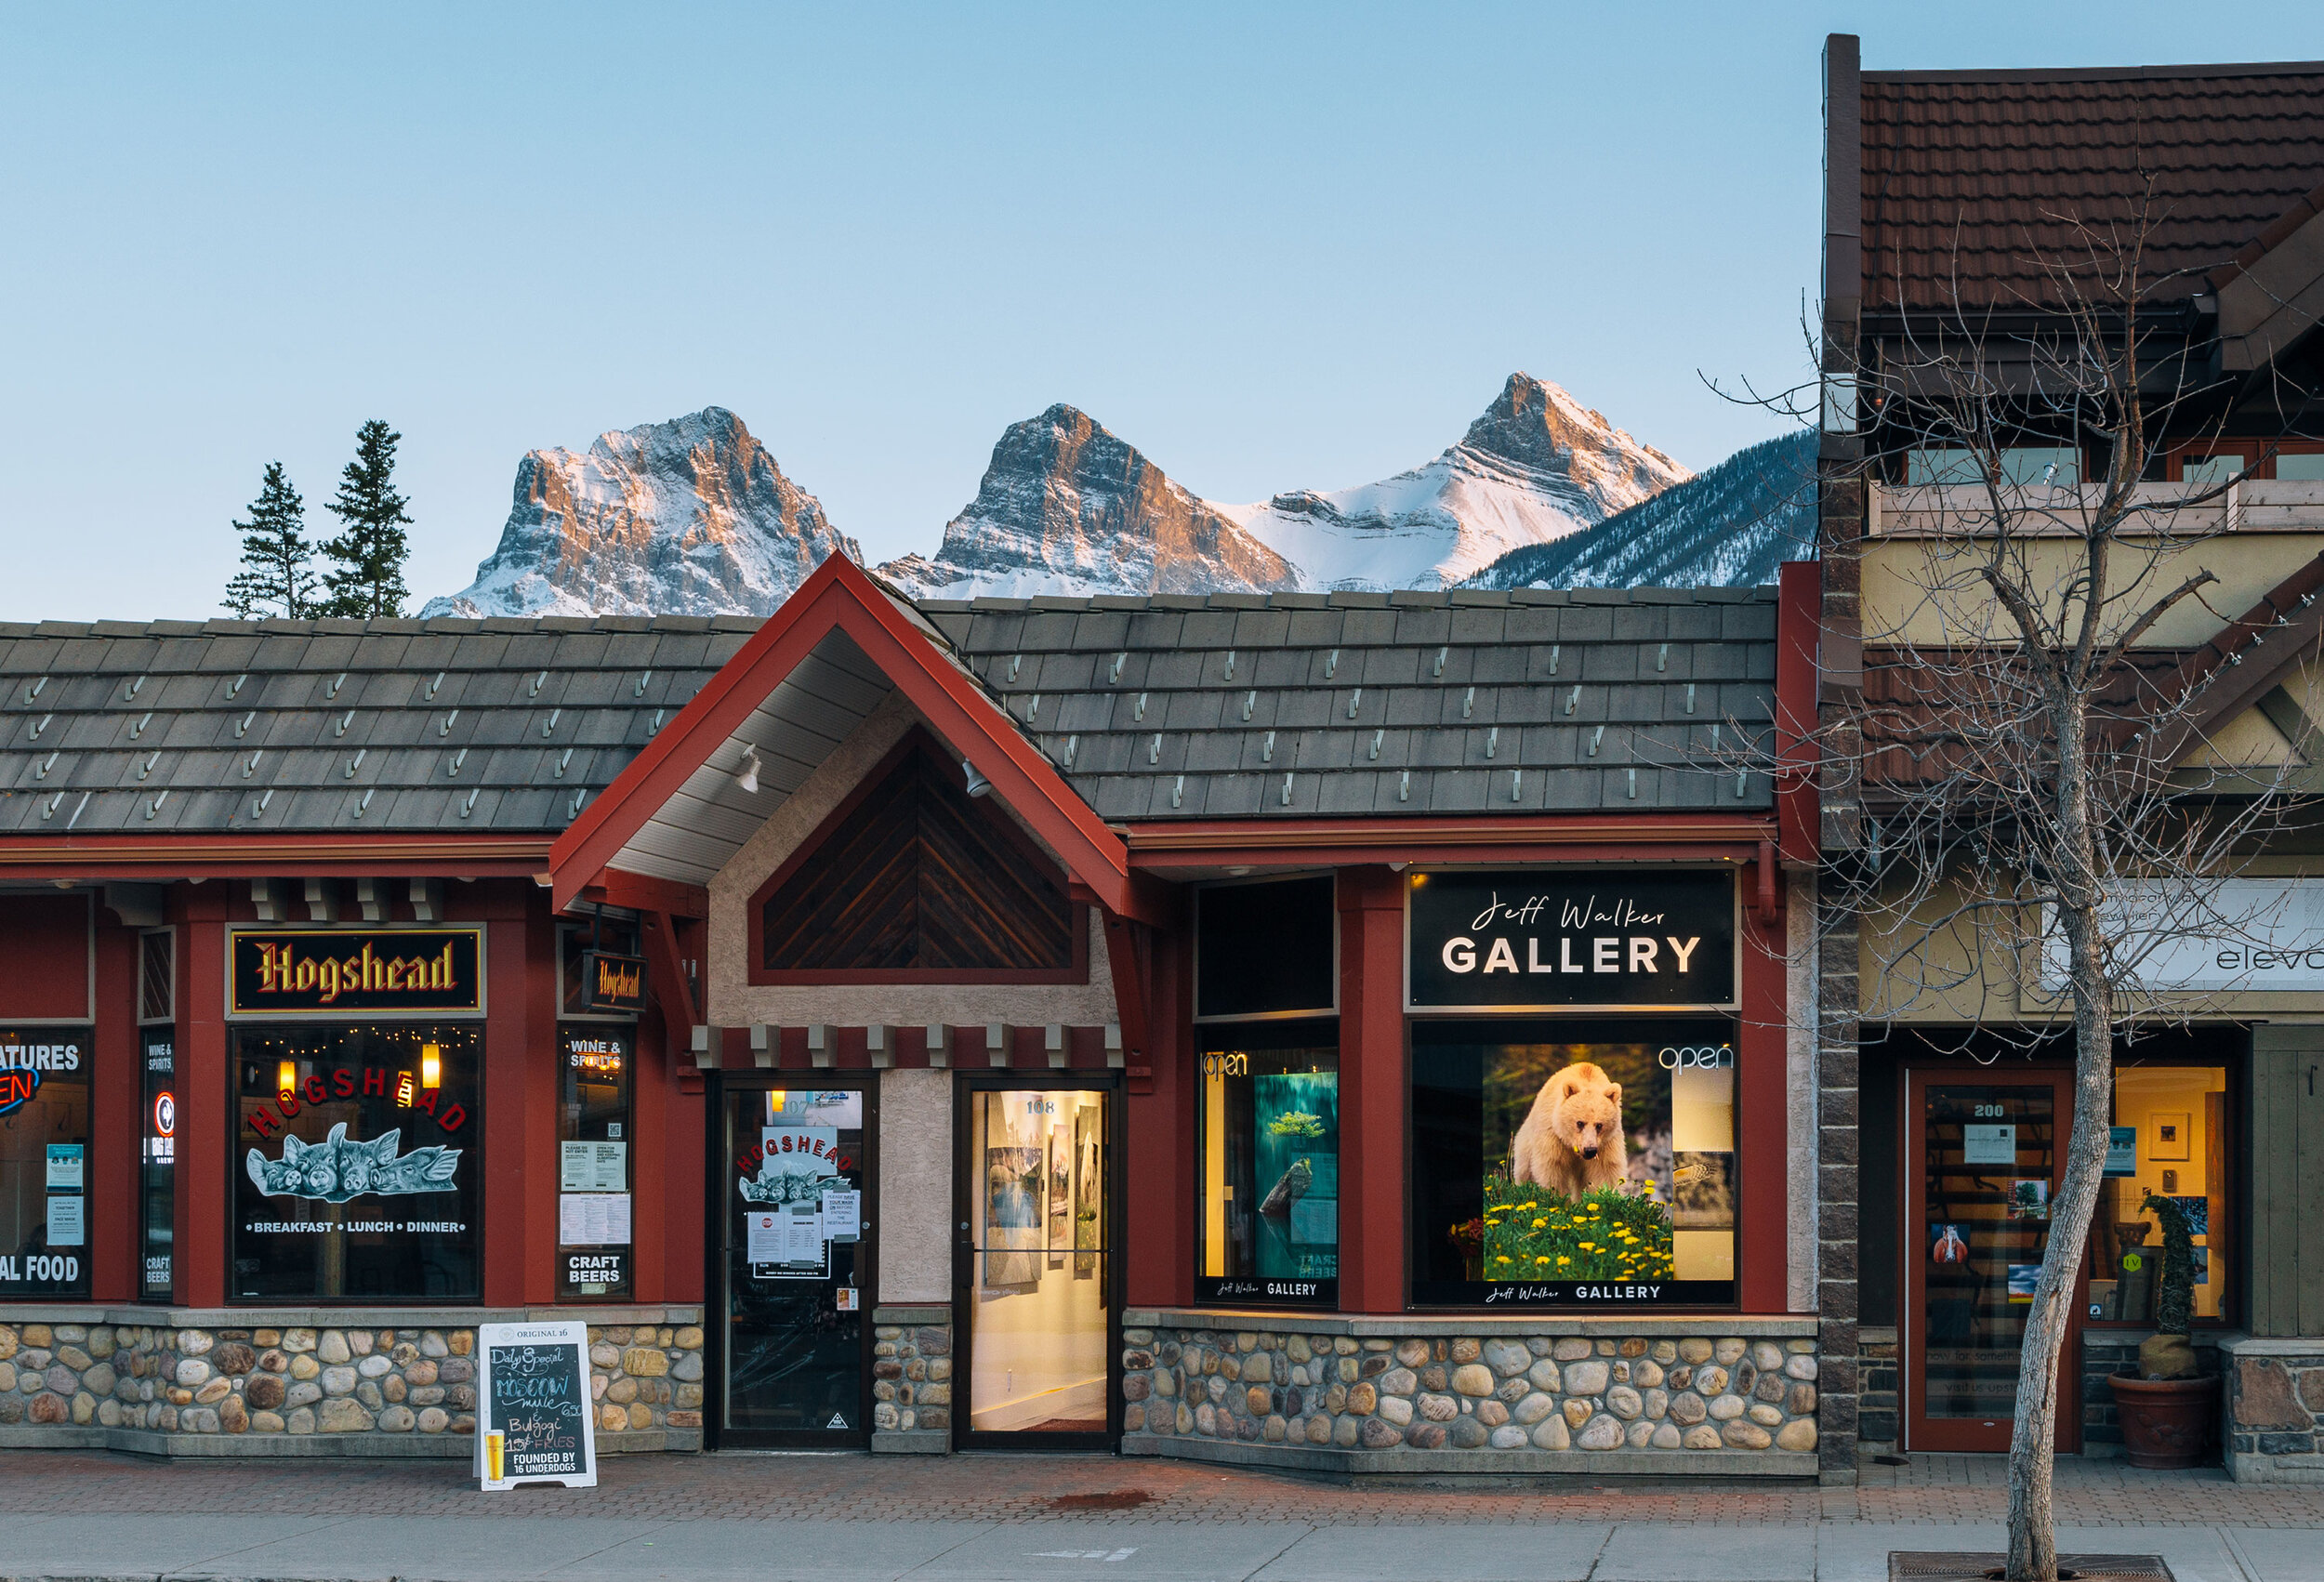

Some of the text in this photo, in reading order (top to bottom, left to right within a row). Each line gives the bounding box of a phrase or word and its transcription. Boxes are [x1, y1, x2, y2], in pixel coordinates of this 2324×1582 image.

[1472, 890, 1665, 930] Jeff Walker
[1442, 936, 1701, 974] GALLERY
[254, 940, 459, 1004] Hogshead
[599, 959, 640, 1004] Hogshead
[149, 1043, 172, 1057] WINE &
[571, 1040, 621, 1054] WINE &
[149, 1058, 172, 1071] SPIRITS
[571, 1054, 621, 1068] SPIRITS
[1204, 1052, 1248, 1081] open
[1658, 1047, 1735, 1076] open
[247, 1068, 467, 1139] HOGSHEAD
[1027, 1101, 1054, 1114] 108
[1974, 1104, 2004, 1117] 200
[737, 1135, 852, 1173] HOGSHEAD
[254, 1221, 459, 1233] BREAKFAST LUNCH DINNER
[26, 1255, 79, 1282] FOOD
[147, 1257, 170, 1270] CRAFT
[569, 1256, 620, 1269] CRAFT
[147, 1271, 170, 1283] BEERS
[569, 1270, 620, 1283] BEERS
[1267, 1283, 1316, 1296] GALLERY
[1486, 1285, 1661, 1303] Jeff Walker GALLERY
[517, 1327, 568, 1338] ORIGINAL 16
[490, 1347, 564, 1373] Daily Special
[495, 1376, 569, 1397] MOSCOW
[508, 1417, 561, 1442] Bulgogi
[535, 1435, 575, 1450] FRIES
[513, 1451, 575, 1465] FOUNDED BY
[514, 1462, 576, 1474] 16 UNDERDOGS
